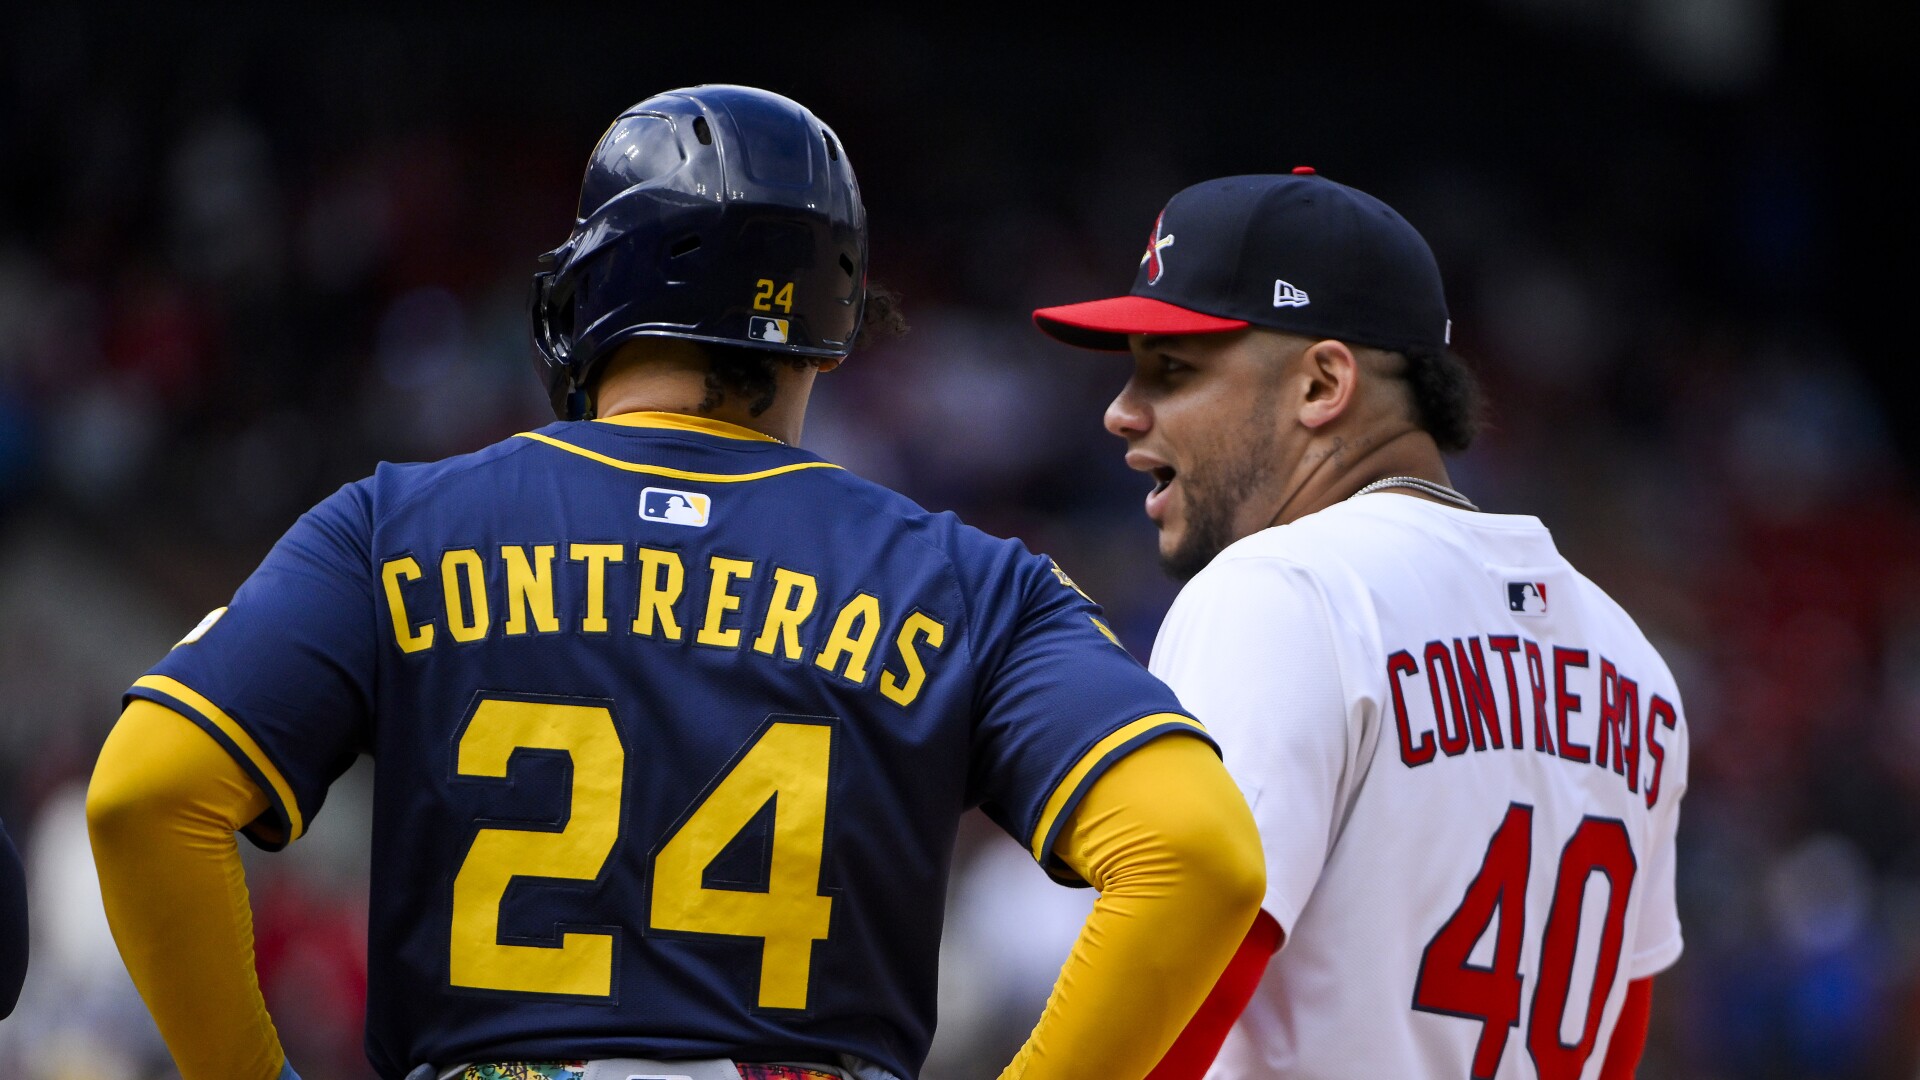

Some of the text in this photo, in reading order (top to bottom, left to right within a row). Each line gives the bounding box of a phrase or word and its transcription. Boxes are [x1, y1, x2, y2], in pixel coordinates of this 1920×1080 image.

[753, 278, 794, 314] 24
[380, 542, 945, 707] CONTRERAS
[1387, 633, 1677, 811] CONTRERAS
[449, 698, 833, 1010] 24
[1411, 800, 1638, 1080] 40
